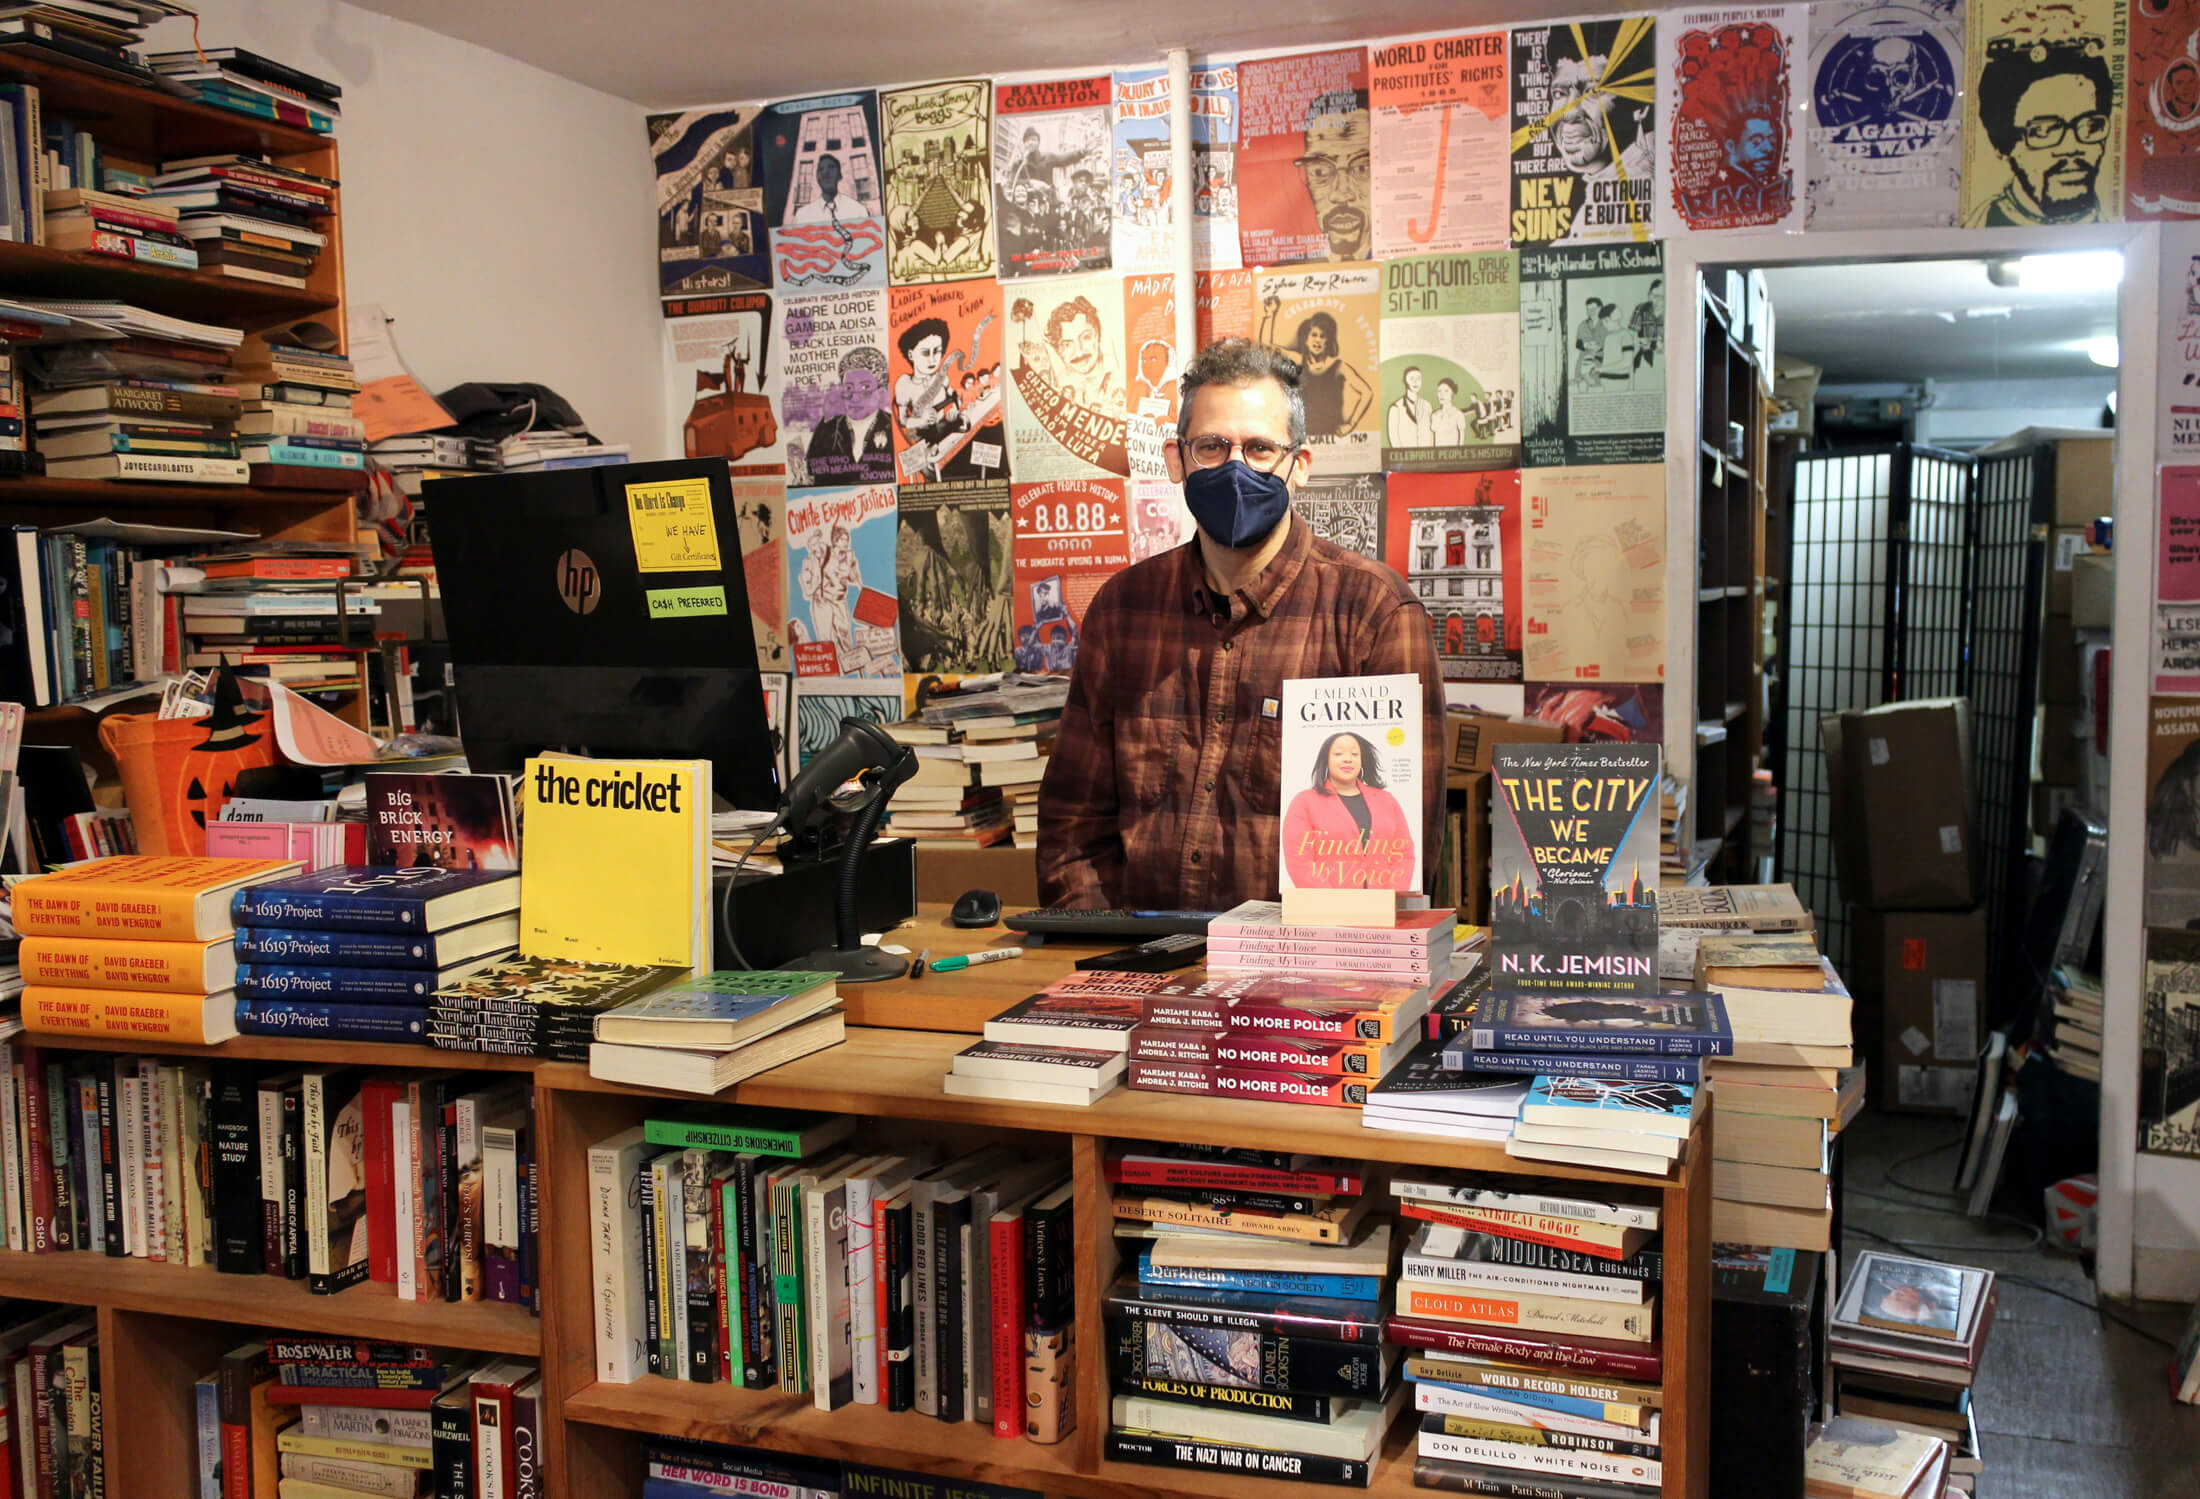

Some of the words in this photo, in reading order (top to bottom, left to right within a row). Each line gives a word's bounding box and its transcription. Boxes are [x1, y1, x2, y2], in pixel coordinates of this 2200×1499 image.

[2113, 0, 2127, 49] ALTER
[1516, 33, 1548, 45] THERE
[1374, 45, 1426, 68] WORLD
[1434, 37, 1502, 60] CHARTER
[1532, 47, 1542, 59] IS
[1461, 65, 1503, 83] RIGHTS
[1520, 74, 1549, 86] THING
[1011, 79, 1095, 97] RAINBOW
[1527, 88, 1548, 100] NEW
[1004, 89, 1100, 108] COALITION
[1517, 102, 1549, 114] UNDER
[1533, 143, 1553, 157] BUT
[1514, 161, 1546, 173] THERE
[1548, 159, 1566, 171] ARE
[1520, 177, 1574, 209] NEW
[1593, 179, 1651, 202] OCTAVIA
[1538, 256, 1596, 278] Highlander
[1598, 252, 1621, 270] Folk
[1623, 248, 1661, 267] School
[1389, 261, 1471, 288] DOCKUM
[1479, 257, 1510, 271] DRUG
[1473, 271, 1509, 286] STORE
[1389, 289, 1437, 311] SIT-IN
[787, 304, 828, 319] AUDRE
[833, 300, 875, 313] LORDE
[785, 321, 836, 334] GAMBDA
[840, 317, 876, 329] ADISA
[790, 337, 825, 349] BLACK
[827, 335, 875, 347] LESBIAN
[790, 350, 838, 363] MOTHER
[784, 362, 836, 375] WARRIOR
[795, 374, 822, 385] POET
[113, 388, 162, 401] MARGARET
[1025, 371, 1060, 407] CHICO
[113, 397, 163, 411] ATWOOD
[1035, 503, 1105, 532] 8.8.88
[666, 525, 677, 536] WE
[683, 525, 706, 536] HAVE
[565, 549, 593, 614] hp
[677, 597, 723, 608] PREFERRED
[1314, 686, 1388, 700] EMERALD
[1300, 700, 1403, 721] GARNER
[1501, 757, 1519, 768] The
[1522, 758, 1541, 767] New
[1545, 757, 1567, 770] York
[1570, 757, 1599, 767] Times
[1600, 757, 1649, 768] Bestseller
[535, 764, 579, 805] the
[586, 770, 681, 813] cricket
[1502, 779, 1563, 811] THE
[1572, 779, 1649, 812] CITY
[391, 830, 452, 843] ENERGY
[1550, 820, 1590, 842] WE
[1298, 829, 1409, 864] Finding
[1533, 847, 1613, 864] BECAME
[1311, 861, 1335, 883] My
[1336, 861, 1404, 886] Voice
[28, 899, 45, 909] THE
[46, 900, 68, 910] DAWN
[70, 901, 80, 910] OF
[96, 902, 118, 912] DAVID
[121, 903, 156, 913] GRAEBER
[255, 902, 282, 917] 1619
[284, 905, 322, 919] Project
[30, 914, 80, 925] EVERYTHING
[97, 917, 119, 927] DAVID
[123, 917, 162, 928] WENGROW
[1502, 954, 1524, 973] N.
[1531, 955, 1551, 974] K.
[1557, 955, 1651, 976] JEMISIN
[1153, 1006, 1189, 1017] MARIAME
[1191, 1009, 1213, 1018] KABA
[1231, 1016, 1250, 1027] NO
[1252, 1016, 1293, 1029] MORE
[1296, 1018, 1342, 1032] POLICE
[1505, 1033, 1530, 1042] READ
[1533, 1034, 1562, 1043] UNTIL
[1565, 1035, 1587, 1044] YOU
[1590, 1036, 1655, 1045] UNDERSTAND
[219, 1141, 248, 1151] NATURE
[686, 1131, 729, 1145] CITIZENSHIP
[731, 1135, 743, 1147] OF
[745, 1137, 792, 1152] DIMENSIONS
[222, 1153, 246, 1162] STUDY
[1119, 1206, 1163, 1218] DESERT
[1168, 1211, 1232, 1226] SOLITAIRE
[36, 1216, 45, 1249] OSHO
[1408, 1264, 1434, 1278] HENRY
[1437, 1266, 1466, 1280] MILLER
[1125, 1306, 1140, 1315] THE
[1144, 1309, 1172, 1318] SLEEVE
[1176, 1311, 1209, 1322] SHOULD
[1214, 1315, 1223, 1323] BE
[1227, 1316, 1259, 1327] ILLEGAL
[1414, 1298, 1462, 1312] CLOUD
[1469, 1301, 1514, 1318] ATLAS
[1448, 1336, 1465, 1348] The
[1466, 1339, 1502, 1352] Female
[1504, 1343, 1531, 1357] Body
[1533, 1348, 1552, 1359] and
[1556, 1350, 1572, 1361] the
[1572, 1352, 1596, 1365] Law
[1481, 1372, 1519, 1386] WORLD
[1523, 1379, 1566, 1393] RECORD
[1570, 1385, 1618, 1400] HOLDERS
[1190, 1385, 1206, 1397] OF
[1210, 1387, 1292, 1410] PRODUCTION
[443, 1421, 456, 1430] RAY
[433, 1430, 470, 1442] KURZWEIL
[1551, 1434, 1614, 1451] ROBINSON
[1175, 1446, 1193, 1461] THE
[1196, 1448, 1217, 1463] NAZI
[1221, 1450, 1242, 1466] WAR
[1245, 1453, 1259, 1468] ON
[1262, 1455, 1301, 1473] CANCER
[1432, 1442, 1458, 1452] DON
[1464, 1446, 1516, 1460] DELILLO
[1534, 1455, 1574, 1468] WHITE
[1581, 1461, 1620, 1473] NOISE
[661, 1465, 686, 1480] HER
[690, 1471, 731, 1487] WORD
[734, 1478, 747, 1489] IS
[751, 1480, 789, 1498] BOND
